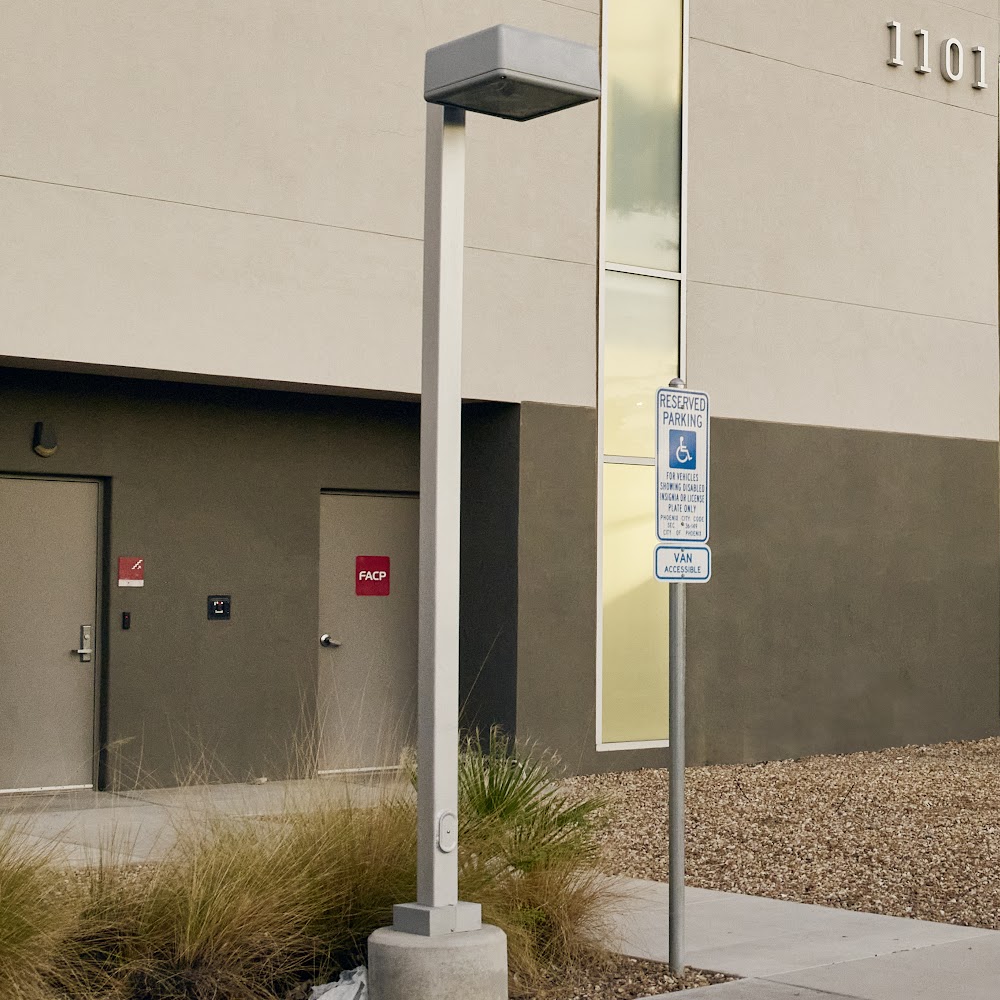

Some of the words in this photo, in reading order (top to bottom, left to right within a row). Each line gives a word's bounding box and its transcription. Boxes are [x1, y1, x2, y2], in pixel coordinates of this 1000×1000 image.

[887, 21, 988, 89] 1101
[660, 394, 706, 411] RESERVED
[663, 411, 702, 428] PARKING
[666, 472, 675, 480] FOR
[677, 473, 698, 482] VEHICLES
[660, 482, 681, 491] SHOWING
[683, 483, 704, 493] DISABLED
[660, 493, 679, 502] INSIGNIA
[680, 494, 686, 502] OR
[687, 494, 704, 503] LICENSE
[668, 503, 682, 512] PLATE
[684, 504, 696, 513] ONLY
[673, 553, 692, 563] VAN
[359, 571, 387, 581] FACP
